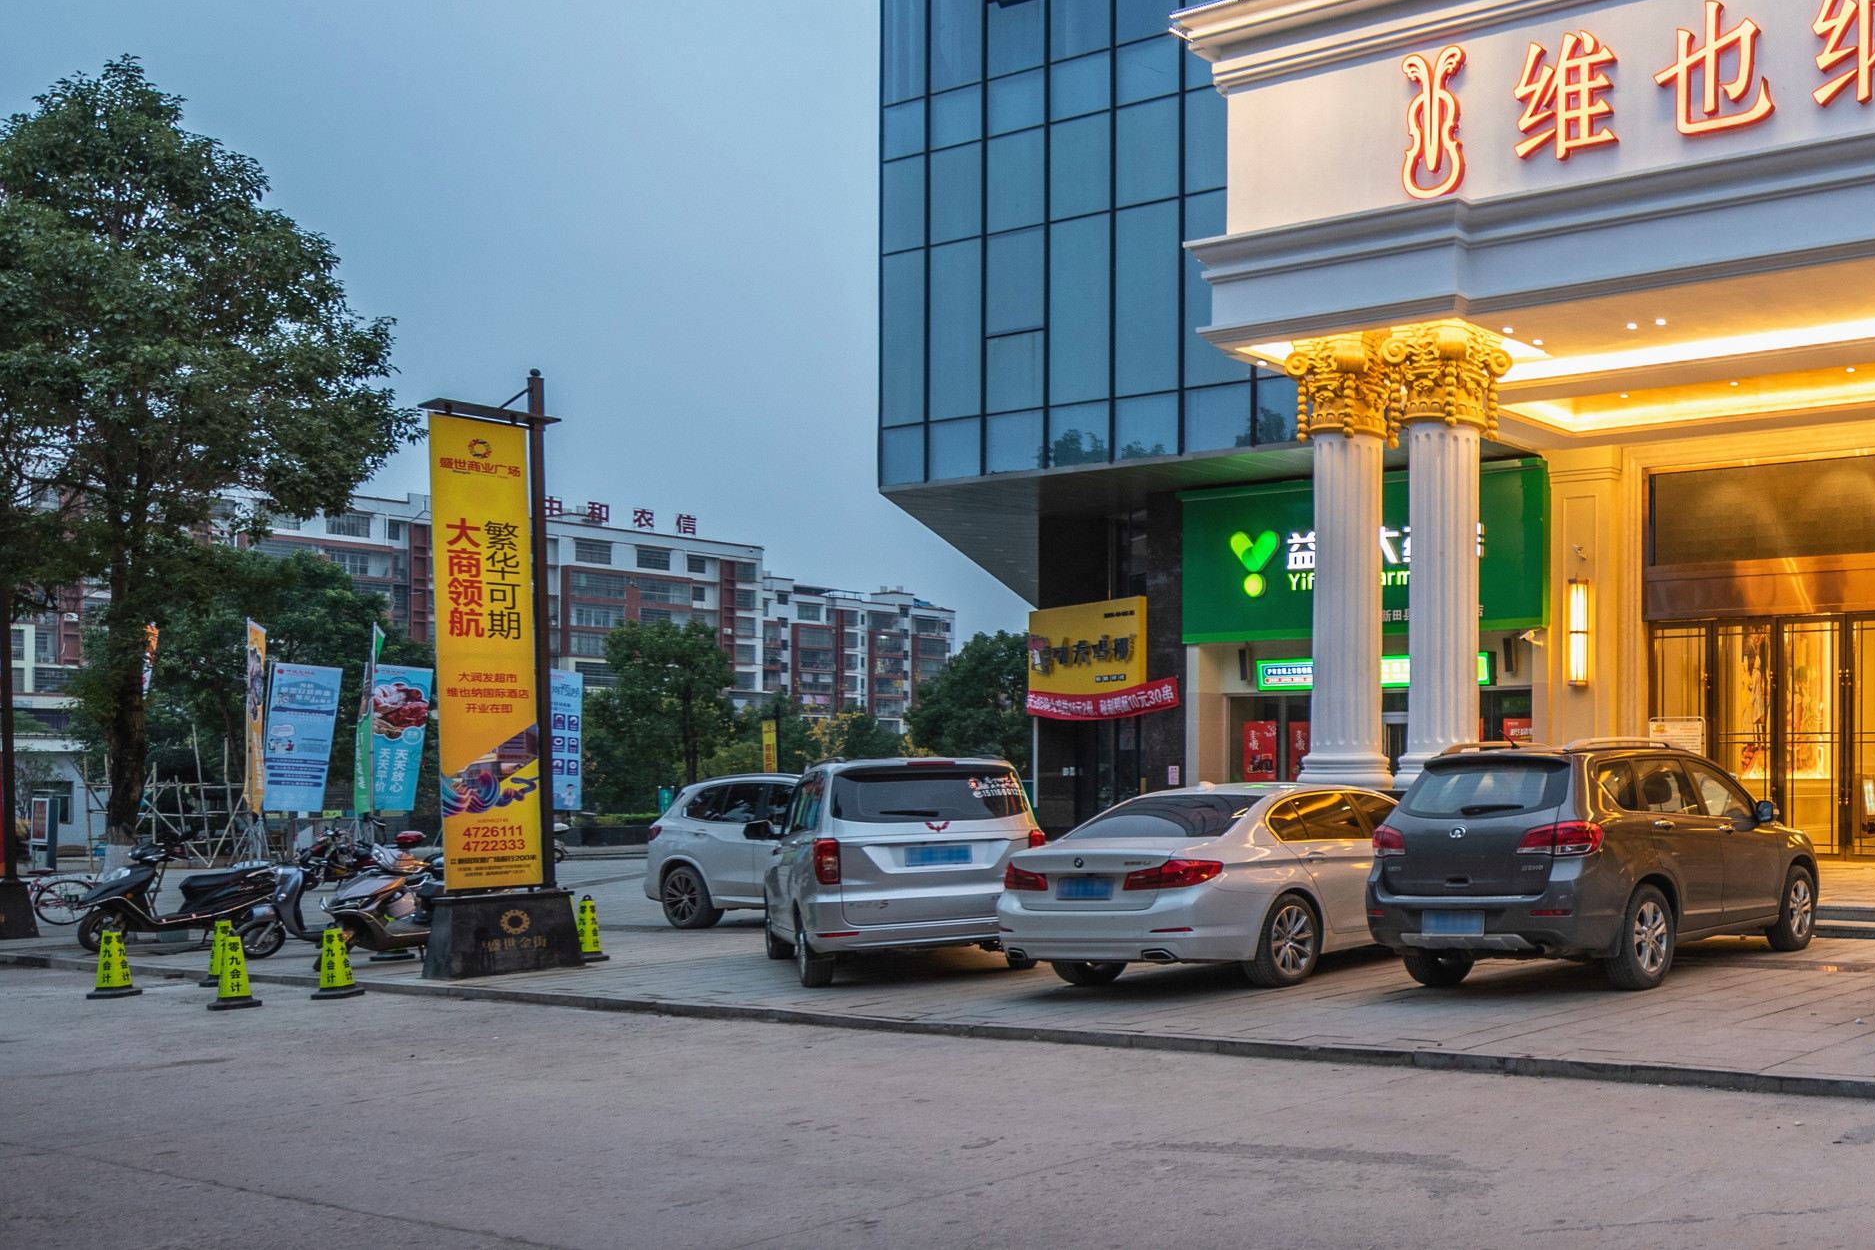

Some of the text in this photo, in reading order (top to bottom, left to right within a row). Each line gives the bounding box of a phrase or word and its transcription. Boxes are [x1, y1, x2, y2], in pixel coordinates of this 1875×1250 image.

[439, 457, 521, 478] 盛世商业广场
[545, 495, 697, 535] 中和农信
[446, 517, 485, 638] 大商领航
[484, 520, 521, 640] 繁华可期
[446, 686, 529, 698] 维也纳国际酒店
[458, 671, 517, 683] 大润发超市
[465, 702, 513, 714] 开业在即
[389, 748, 409, 793] 天天放心
[462, 825, 523, 839] 4726111
[462, 839, 526, 853] 4722333
[102, 935, 112, 984] 零九会计
[229, 941, 243, 993] 零九会计
[325, 934, 335, 984] 零九会计
